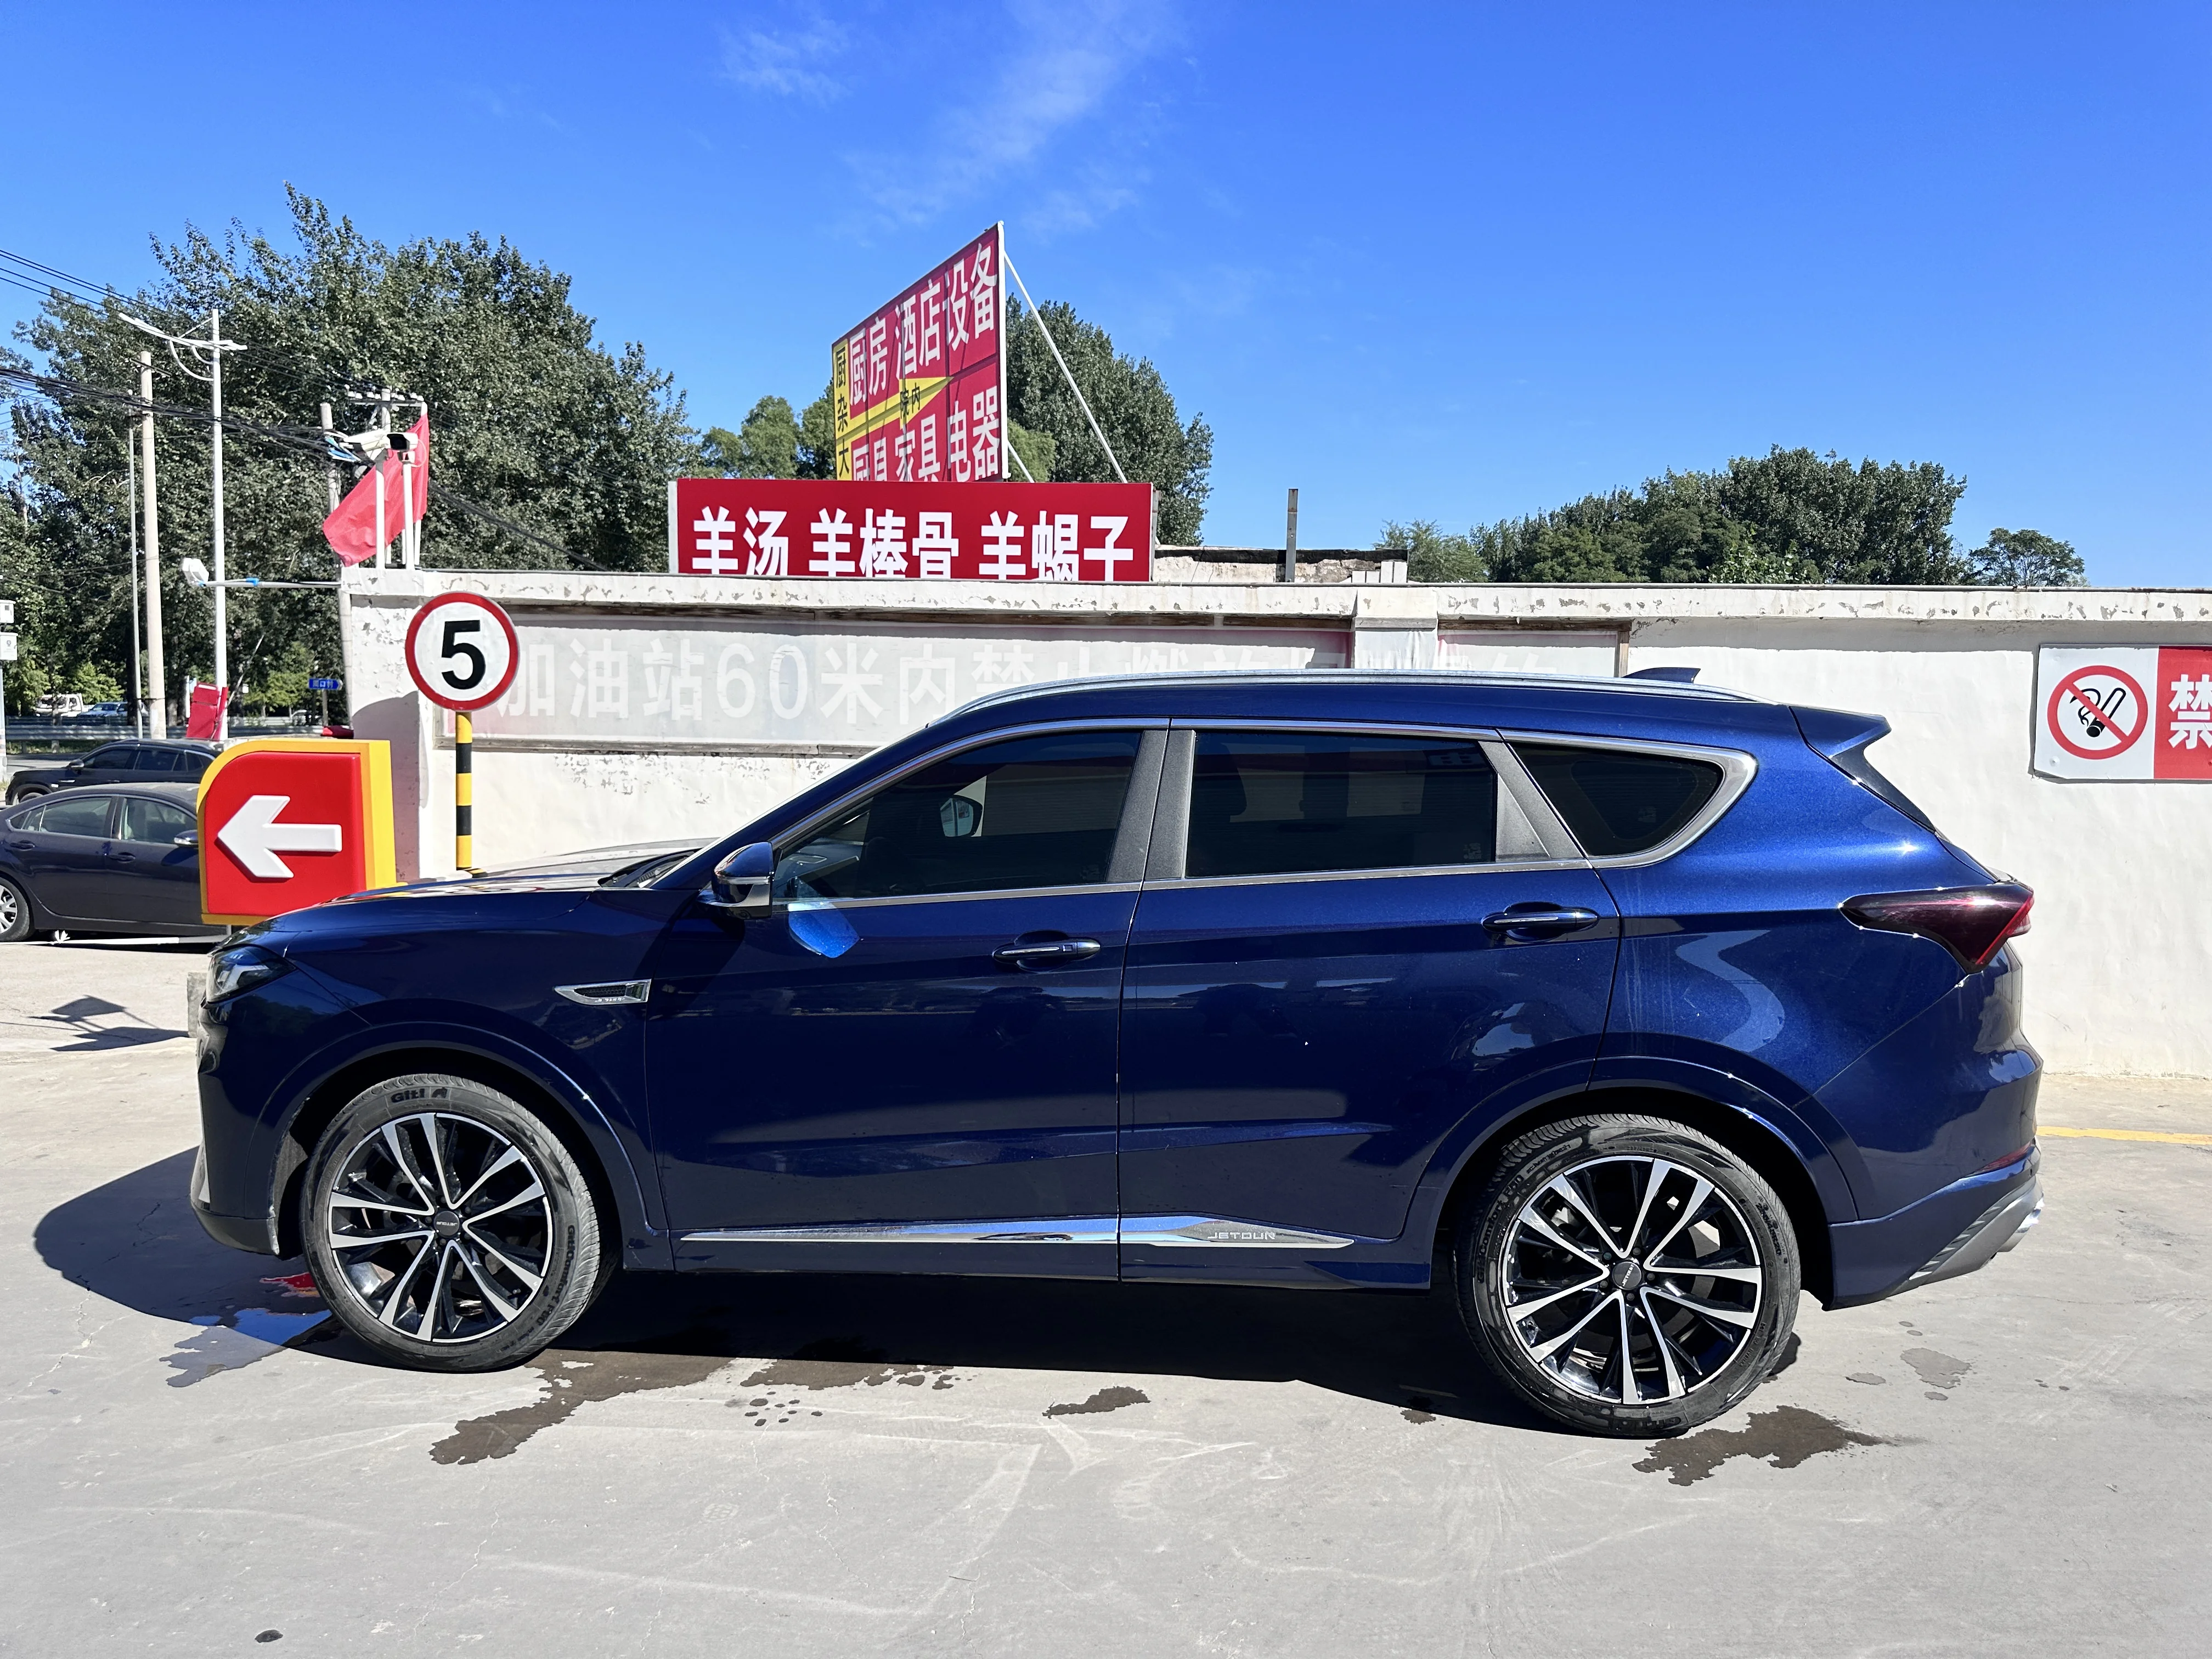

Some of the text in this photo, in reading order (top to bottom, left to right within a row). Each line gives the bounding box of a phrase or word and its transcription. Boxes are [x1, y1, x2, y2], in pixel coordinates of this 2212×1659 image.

[850, 317, 888, 406] 厨房
[900, 382, 921, 419] 院内
[947, 386, 1000, 482] 电器
[692, 506, 1134, 582] 羊汤 羊棒骨 羊蝎子
[442, 620, 486, 690] 5
[2168, 674, 2212, 749] 禁
[391, 1088, 425, 1103] Giti
[1207, 1231, 1276, 1240] JETOUR
